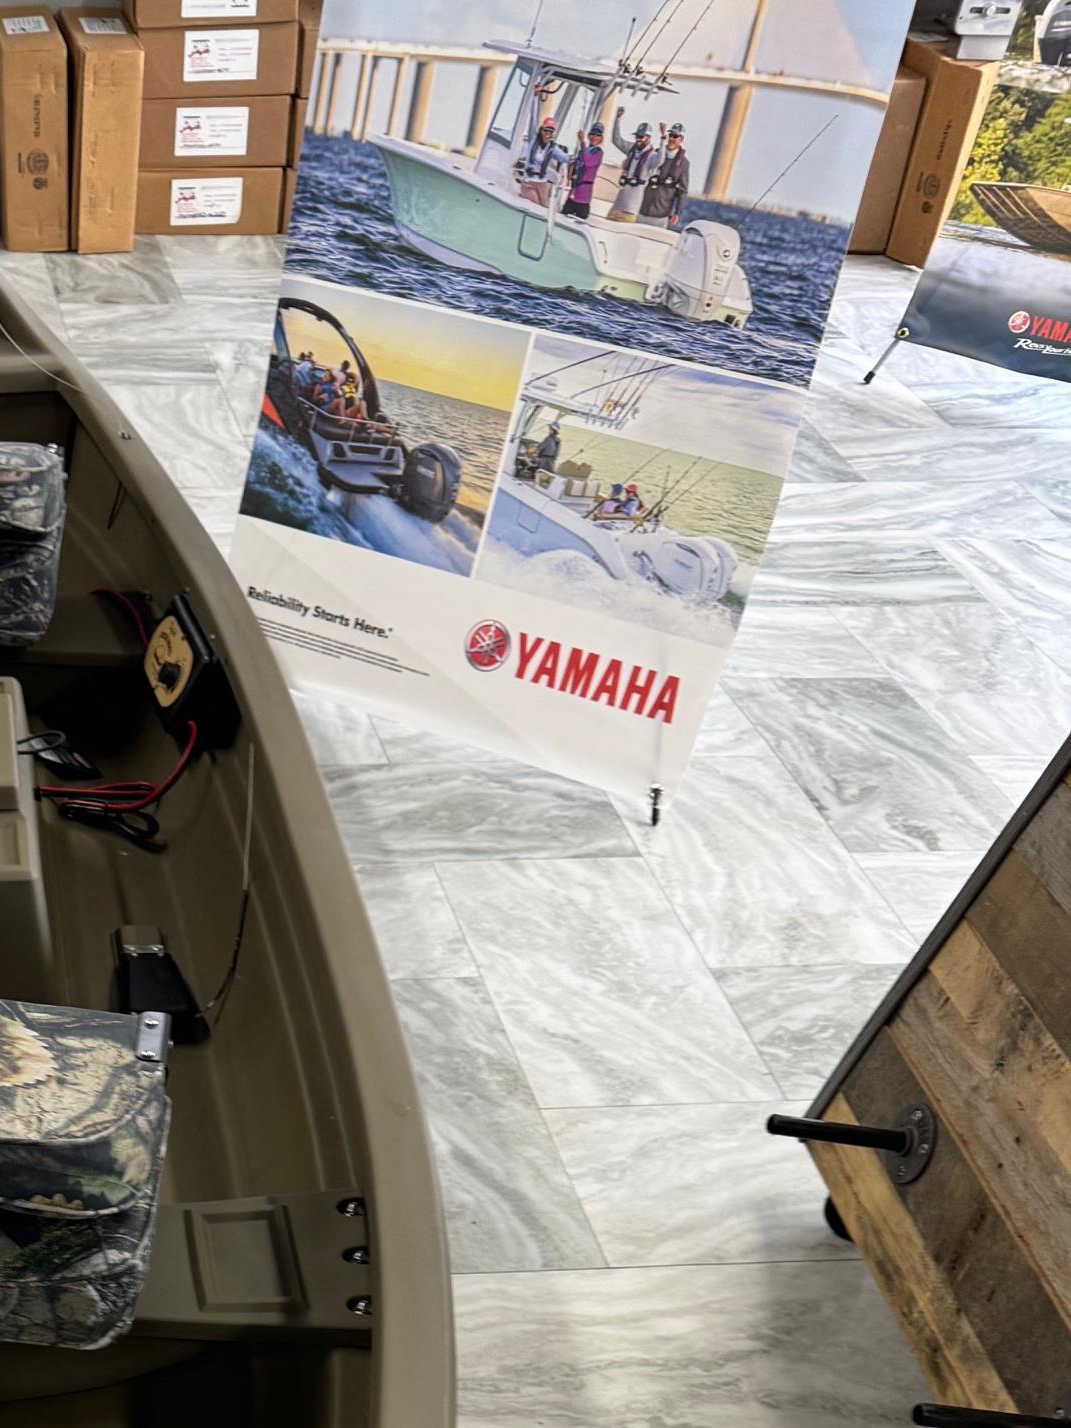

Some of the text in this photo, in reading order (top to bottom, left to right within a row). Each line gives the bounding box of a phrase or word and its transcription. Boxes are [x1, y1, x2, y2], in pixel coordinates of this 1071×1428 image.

[247, 586, 310, 617] Reliability
[312, 605, 350, 628] Starts
[514, 632, 680, 724] YAMAHA
